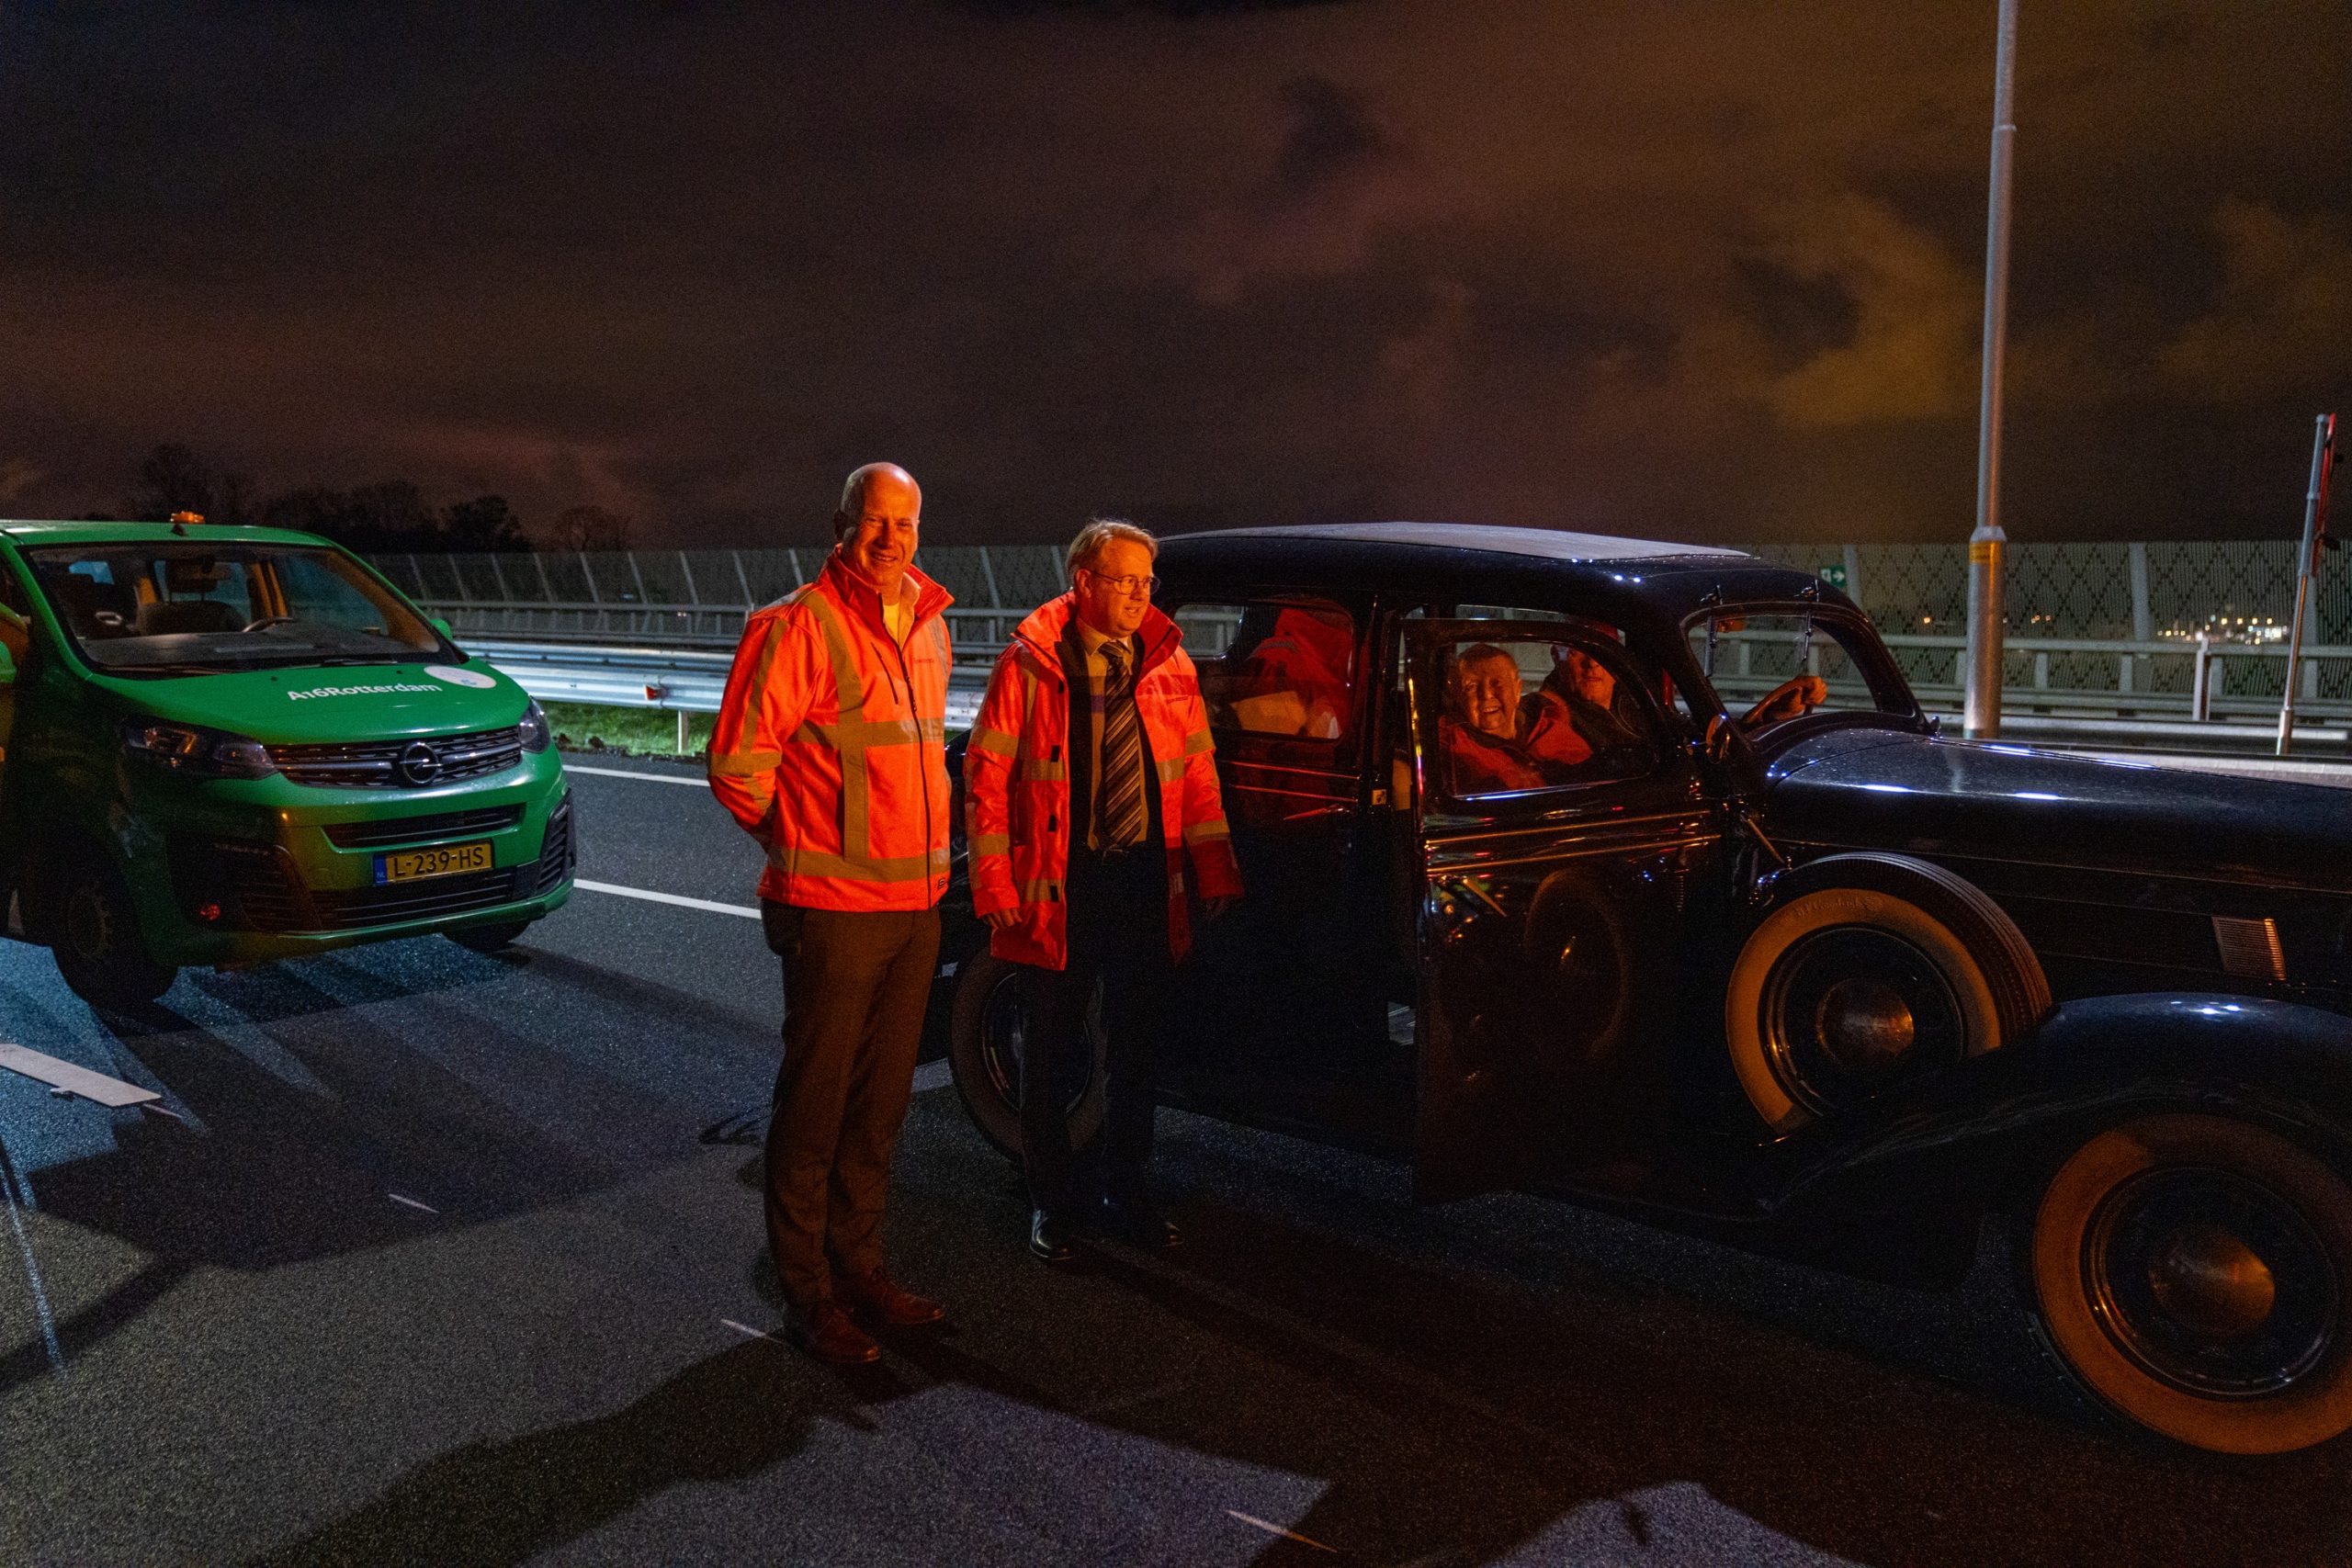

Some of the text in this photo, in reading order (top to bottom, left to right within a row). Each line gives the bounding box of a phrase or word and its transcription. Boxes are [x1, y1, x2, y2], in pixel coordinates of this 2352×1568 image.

[287, 682, 444, 701] A16Rotterdam
[394, 846, 485, 877] L-239-HS
[376, 871, 386, 879] NL
